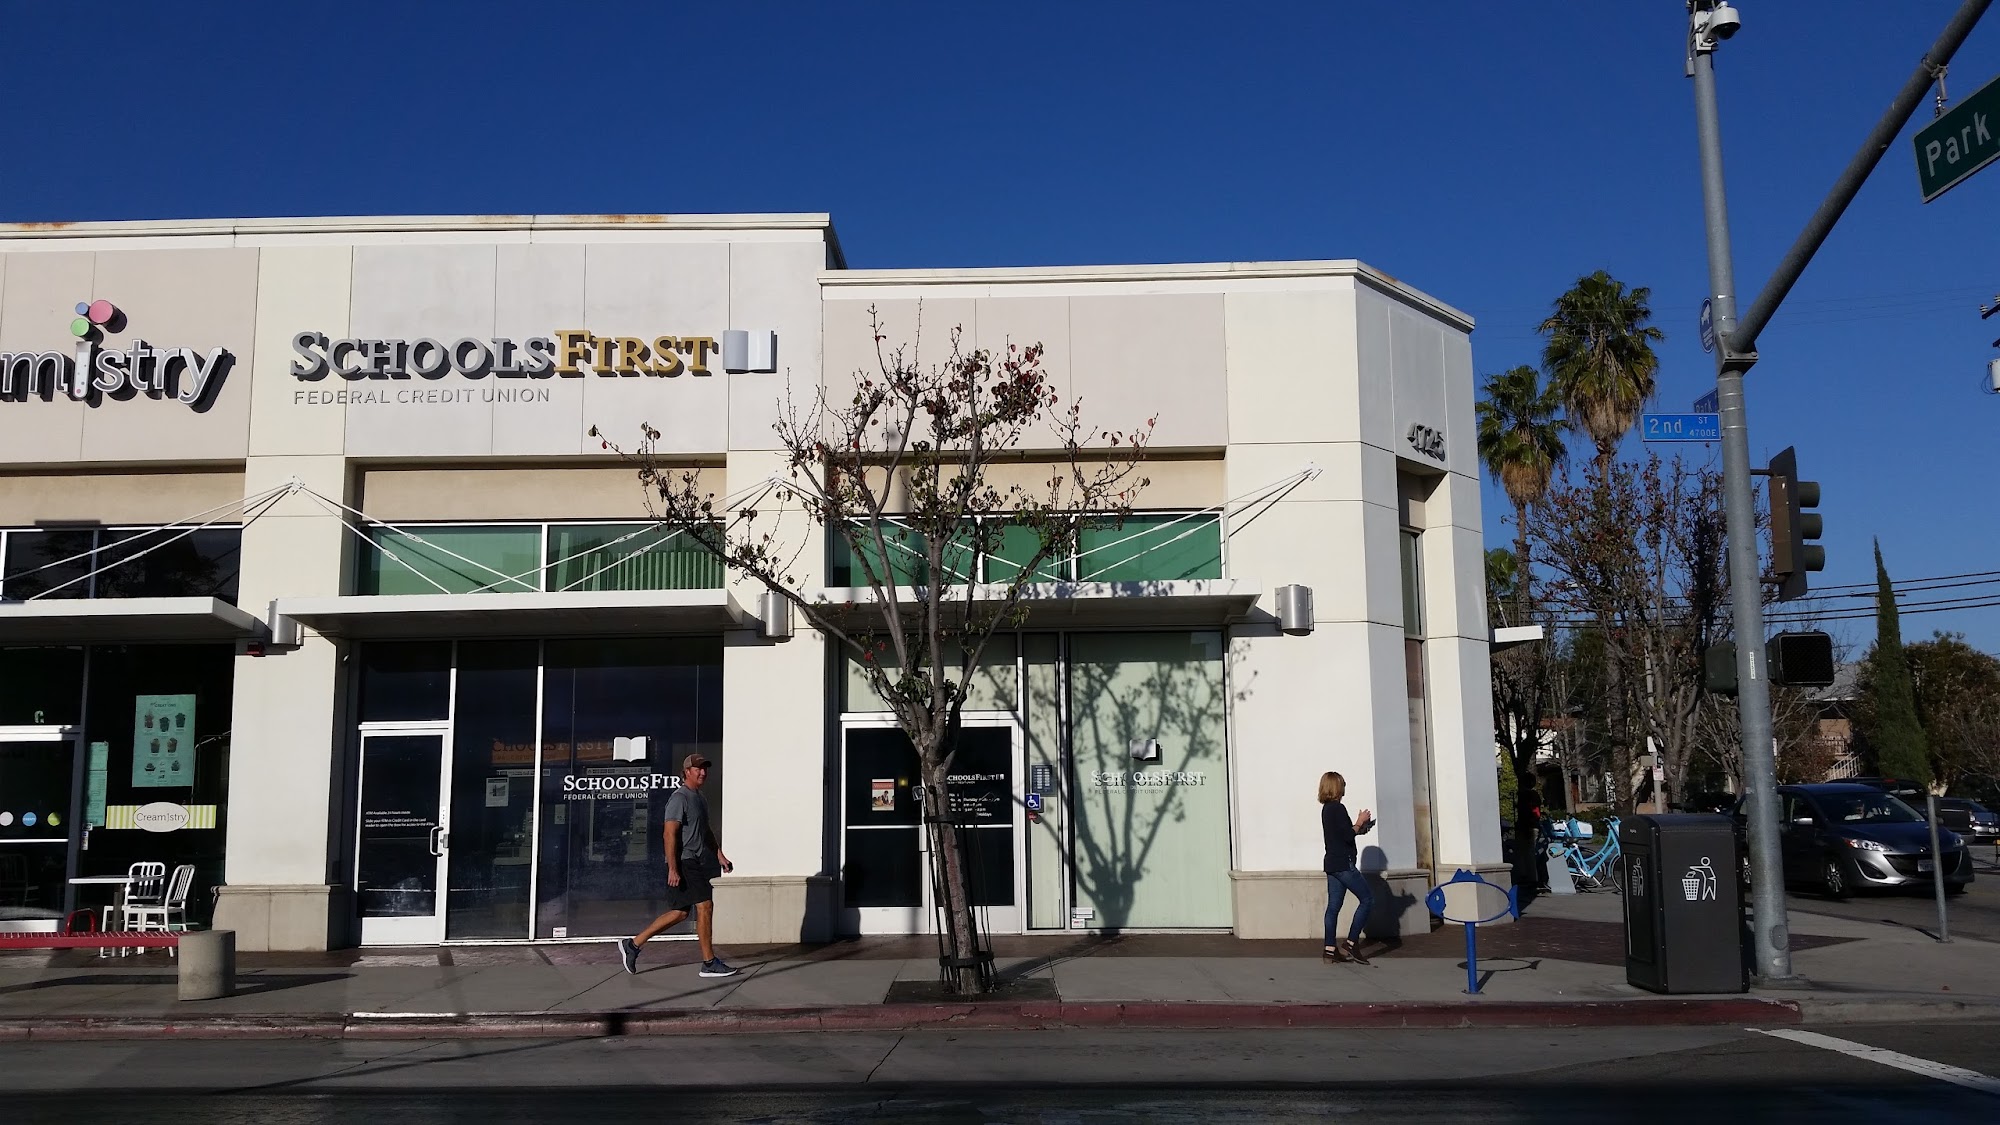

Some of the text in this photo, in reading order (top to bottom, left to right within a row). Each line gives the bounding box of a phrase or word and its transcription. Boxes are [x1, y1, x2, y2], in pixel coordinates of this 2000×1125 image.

[1925, 111, 1992, 178] Park
[290, 330, 715, 377] SCHOOLSFIRST
[293, 387, 550, 405] FEDERAL CREDIT UNION
[1649, 416, 1708, 434] 2nd ST
[1689, 429, 1717, 437] 4700E
[1406, 422, 1445, 456] 4725
[563, 773, 685, 791] SCHOOLSFIR
